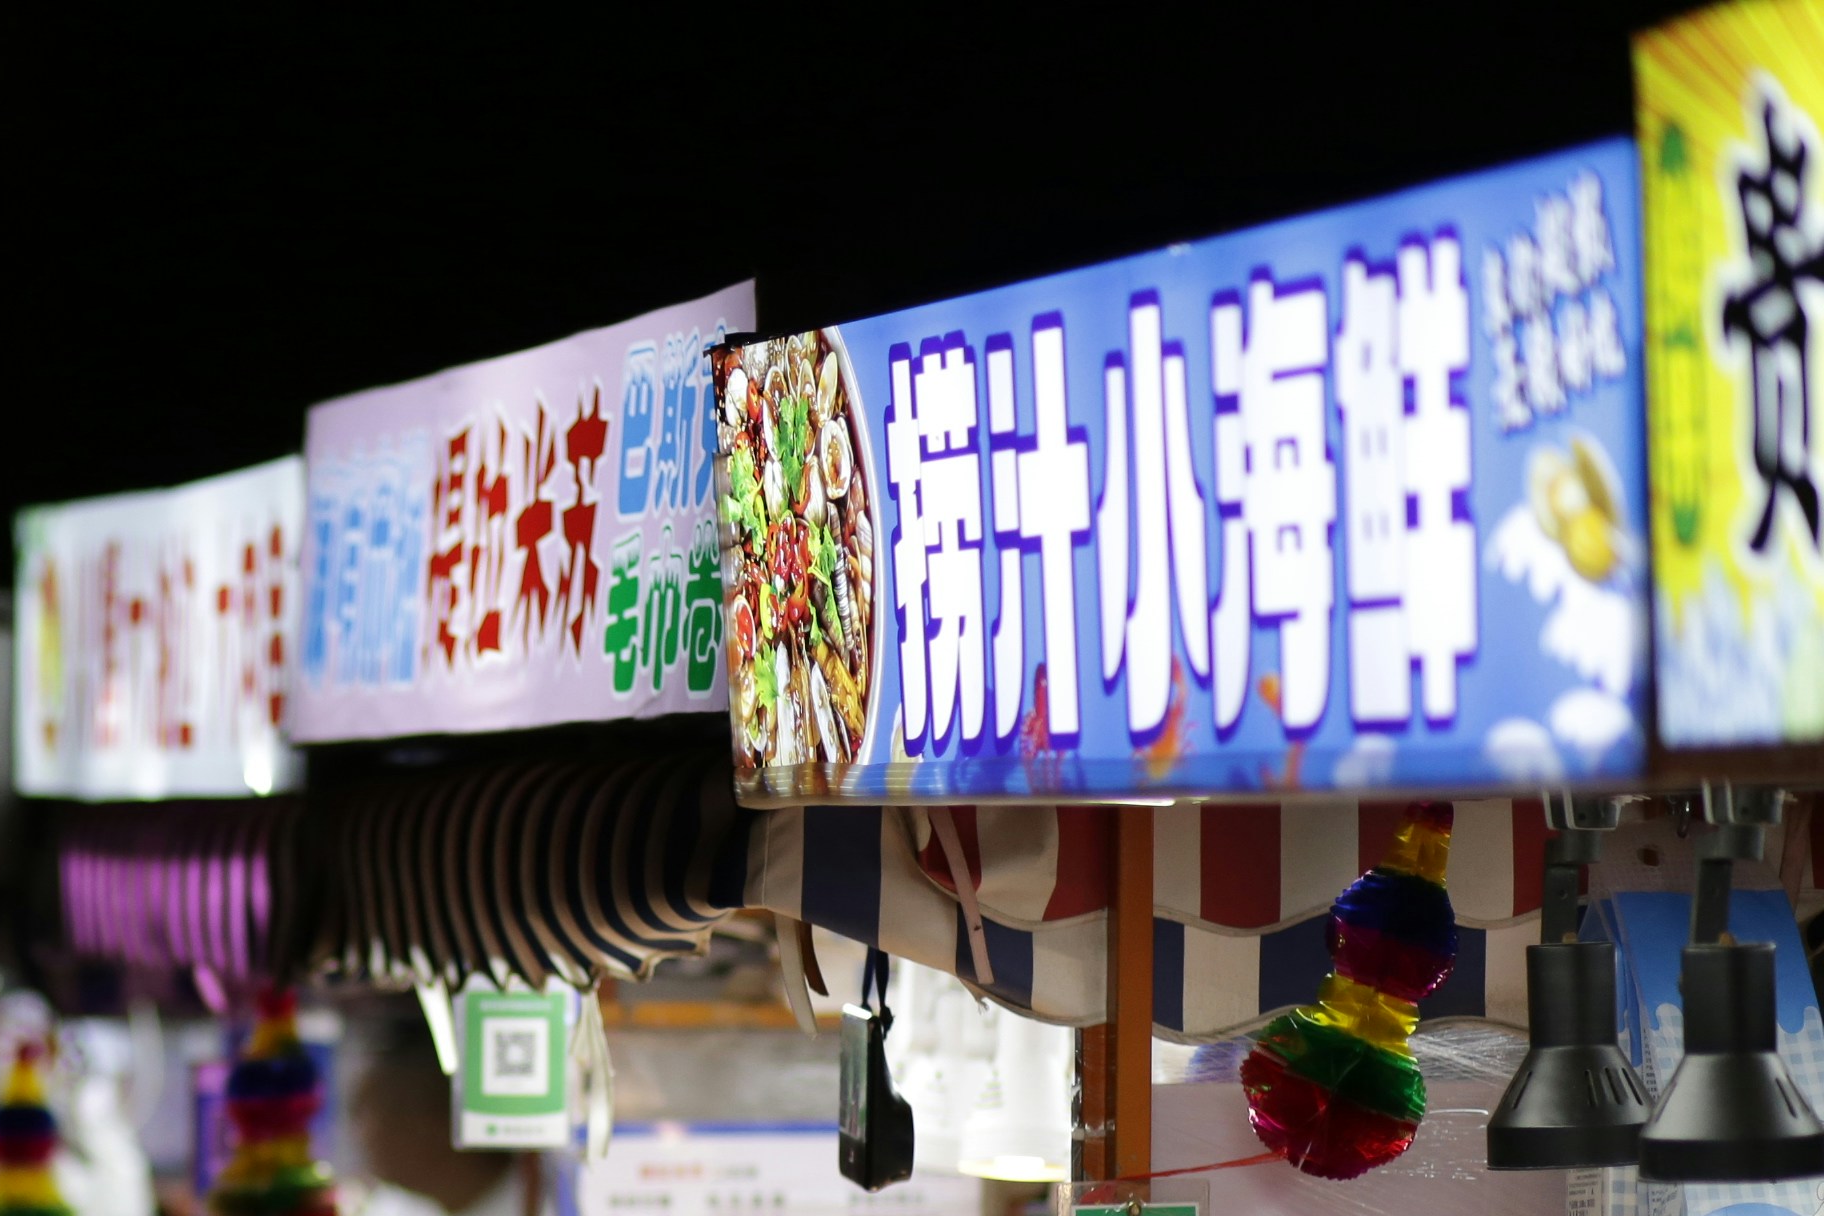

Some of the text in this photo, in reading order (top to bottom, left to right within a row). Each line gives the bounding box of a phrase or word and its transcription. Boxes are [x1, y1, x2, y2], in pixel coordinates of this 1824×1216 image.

[885, 224, 1477, 758] 捞汁小海鲜
